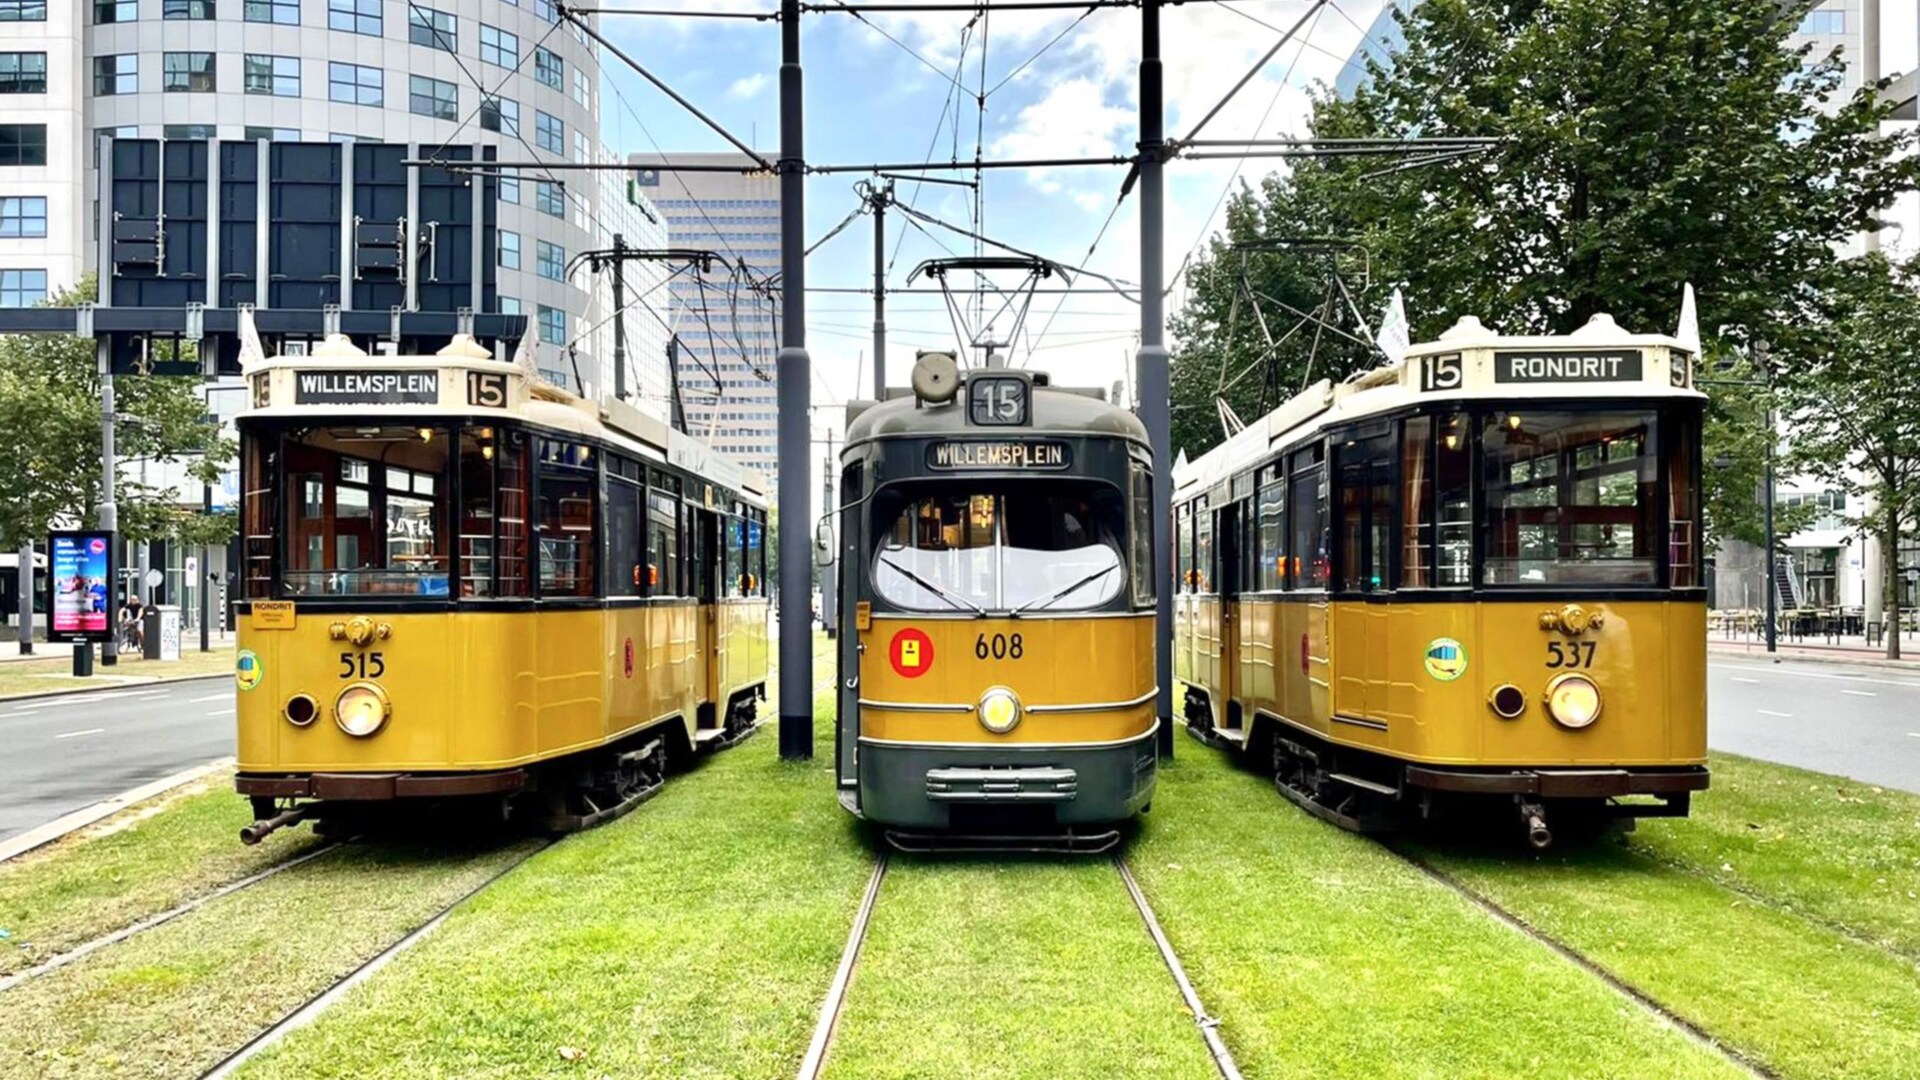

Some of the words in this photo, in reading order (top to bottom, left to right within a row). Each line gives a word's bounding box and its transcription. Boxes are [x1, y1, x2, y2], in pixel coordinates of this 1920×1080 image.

[1425, 355, 1461, 390] 15
[1511, 357, 1623, 379] RONDRIT
[301, 375, 437, 393] WILLEMSPLEIN
[469, 375, 504, 406] 15
[983, 385, 1018, 418] 15
[936, 446, 1062, 464] WILLEMSPLEIN
[975, 633, 1024, 660] 608
[1545, 641, 1597, 669] 537
[339, 652, 385, 679] 515
